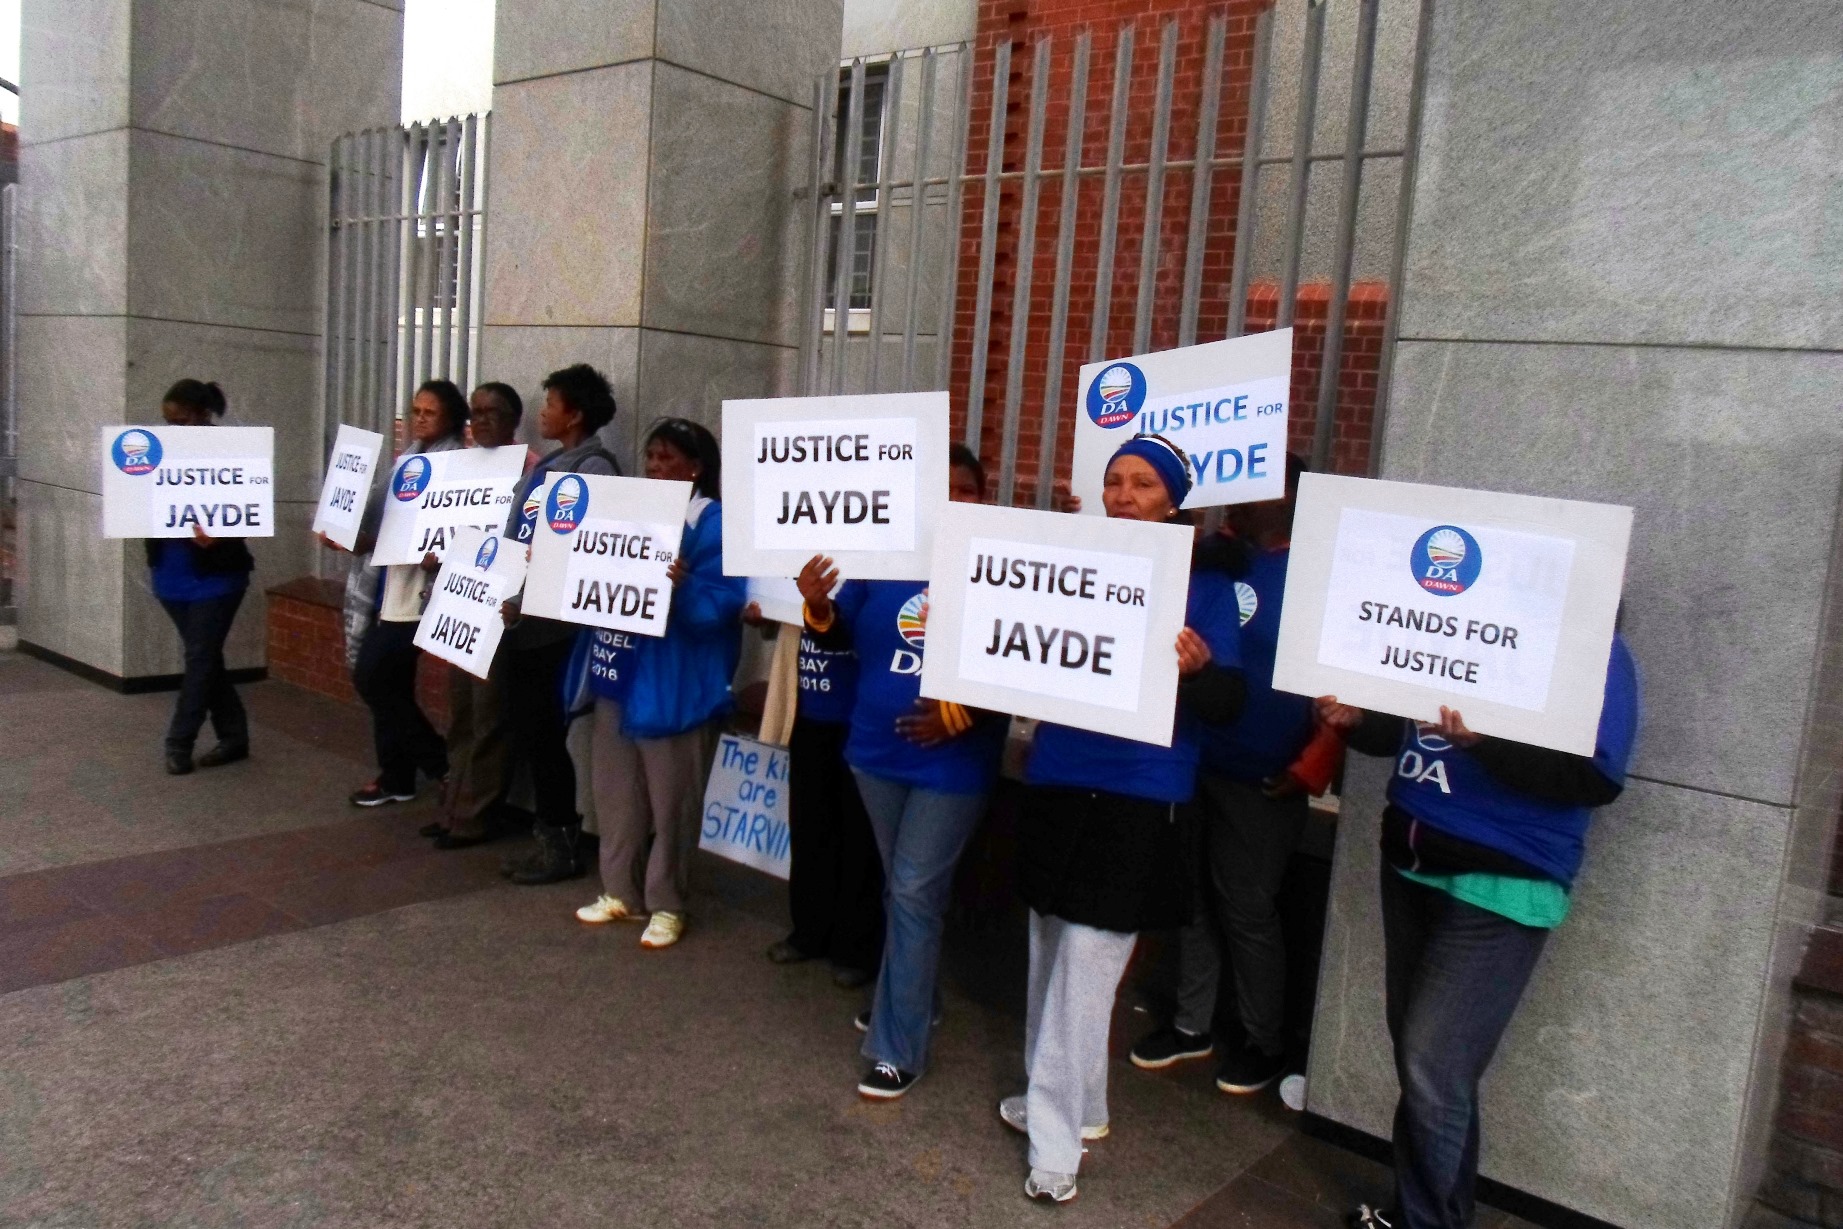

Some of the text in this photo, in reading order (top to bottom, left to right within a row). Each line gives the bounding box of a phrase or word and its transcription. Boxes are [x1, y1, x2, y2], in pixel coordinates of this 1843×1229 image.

[1100, 413, 1129, 424] DAWN
[1101, 400, 1128, 415] DA
[1139, 395, 1283, 435] JUSTICE FOR
[126, 456, 149, 465] DA
[757, 434, 914, 463] JUSTICE FOR
[336, 452, 361, 473] JUSTICE
[1190, 442, 1268, 487] YDE
[156, 468, 243, 486] JUSTICE
[249, 476, 269, 485] FOR
[400, 483, 418, 492] DA
[330, 486, 356, 512] JAYDE
[421, 487, 512, 510] JUSTICE FOR
[777, 490, 890, 525] JAYDE
[166, 504, 260, 527] JAYDE
[554, 509, 574, 520] DA
[518, 523, 533, 539] D
[573, 530, 673, 563] JUSTICE FOR
[970, 554, 1146, 607] JUSTICE FOR
[1424, 580, 1459, 591] DAWN
[1425, 566, 1458, 582] DA
[443, 572, 497, 608] JUSTICE FOR
[572, 579, 658, 620] JAYDE
[430, 613, 480, 655] JAYDE
[1358, 600, 1519, 650] STANDS FOR
[593, 643, 617, 663] BAY
[986, 618, 1116, 676] JAYDE
[889, 649, 922, 676] D
[1381, 645, 1480, 684] JUSTICE
[800, 676, 831, 692] 016
[722, 739, 789, 782] The ki
[1398, 749, 1451, 794] DA
[738, 780, 777, 808] are
